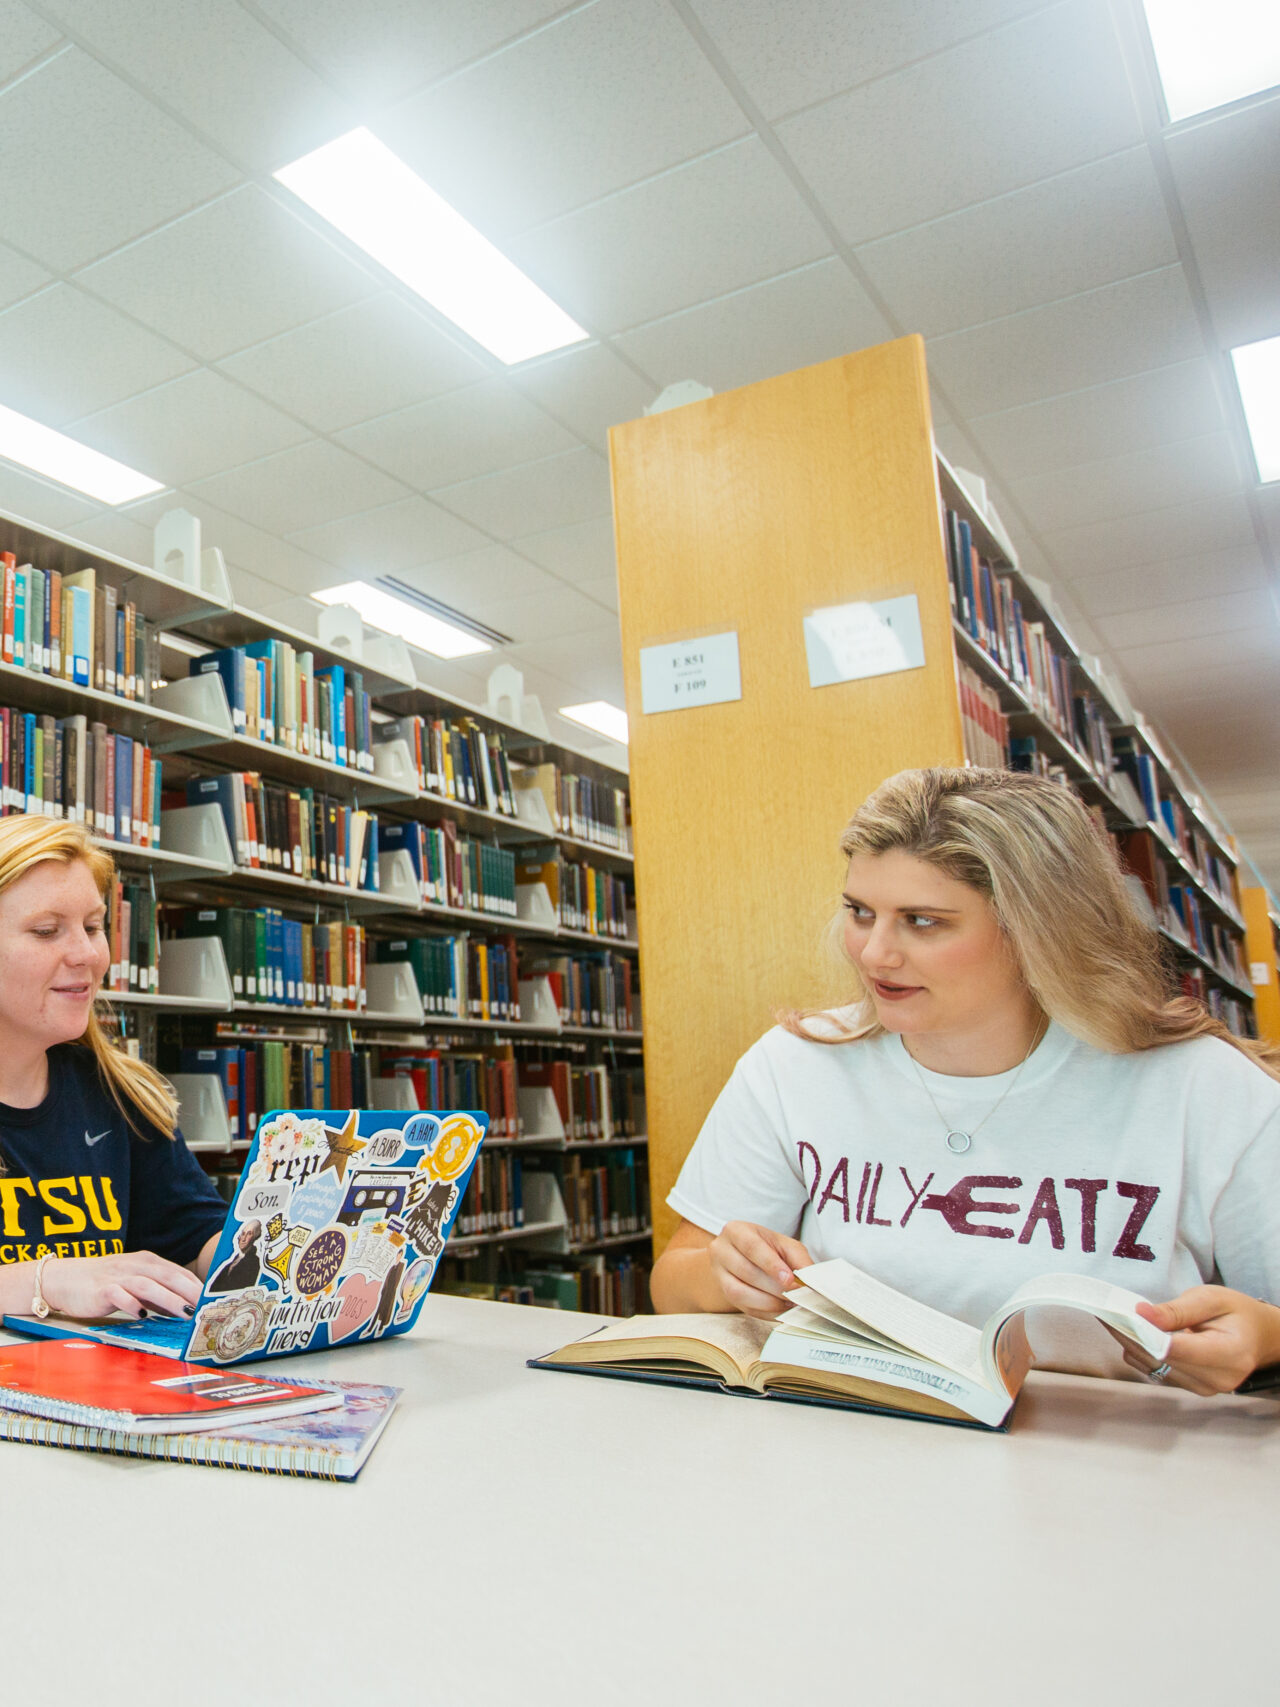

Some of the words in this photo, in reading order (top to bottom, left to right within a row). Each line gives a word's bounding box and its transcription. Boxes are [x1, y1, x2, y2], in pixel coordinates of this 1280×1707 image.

[685, 654, 705, 666] 851
[687, 680, 707, 692] 109
[268, 1155, 320, 1186] rep
[248, 1191, 279, 1210] Son.
[797, 1141, 935, 1228] DAILY
[919, 1175, 1161, 1262] EATZ
[302, 1245, 341, 1276] STRONG
[308, 1246, 324, 1258] SEE
[300, 1262, 338, 1288] WOMAN
[268, 1295, 342, 1327] nutrition
[270, 1321, 316, 1351] nerd
[862, 1356, 889, 1372] STATE
[890, 1362, 943, 1390] TENNESSEE
